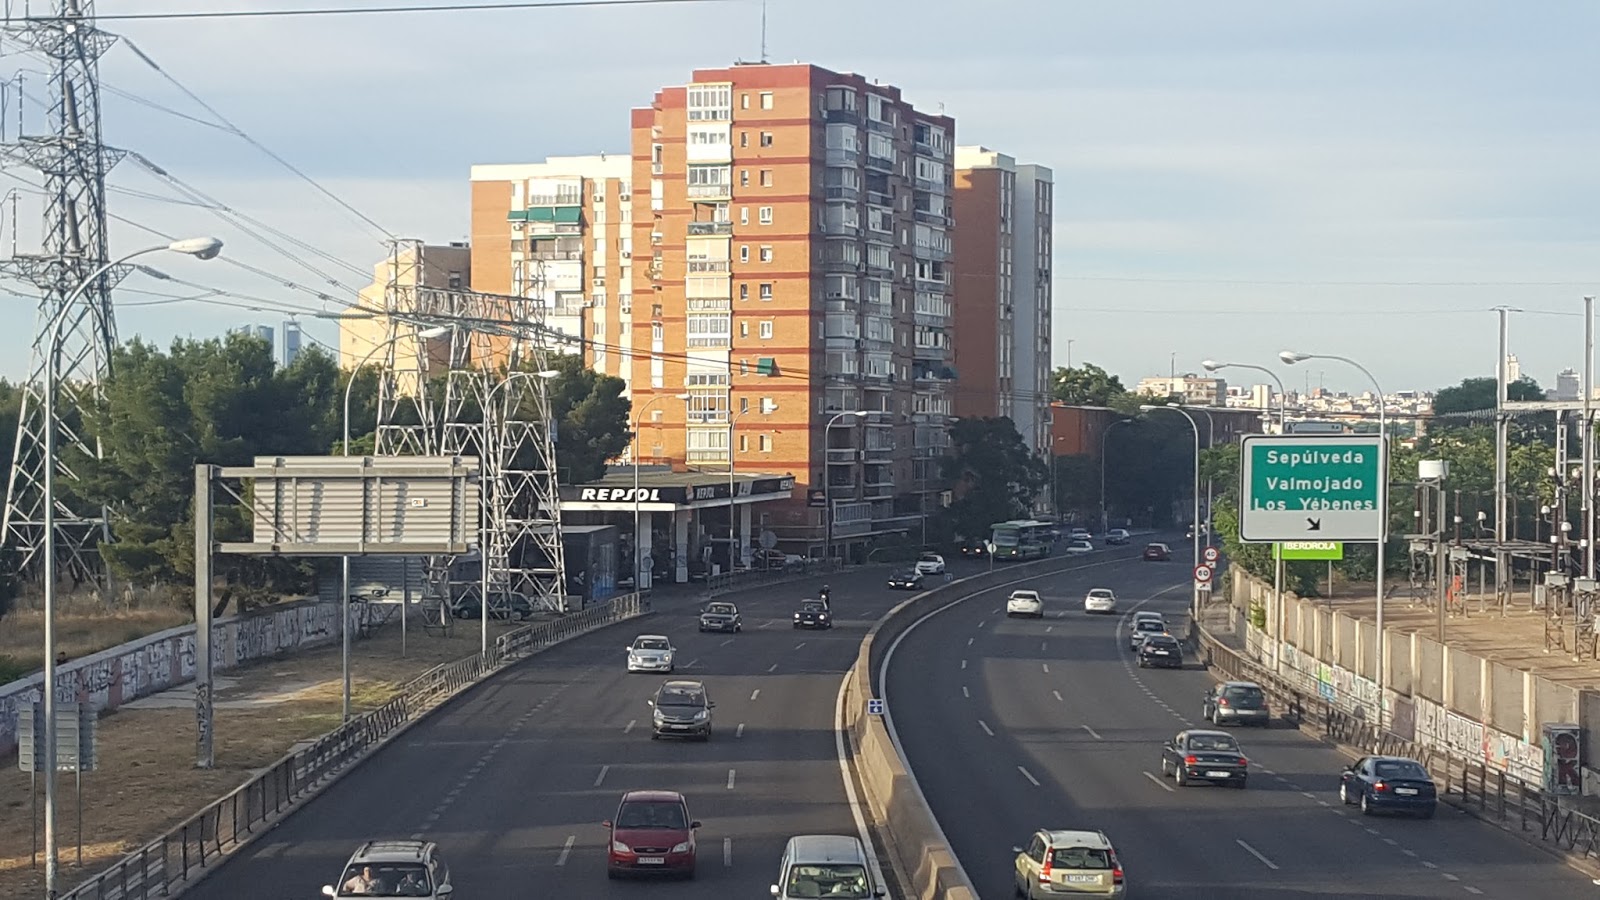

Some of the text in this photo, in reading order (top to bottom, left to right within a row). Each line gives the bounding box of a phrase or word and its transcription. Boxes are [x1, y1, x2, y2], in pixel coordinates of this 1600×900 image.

[1266, 449, 1364, 467] Sepúlveda
[1266, 476, 1363, 493] Valmojado
[581, 488, 660, 501] REPSOL
[1254, 497, 1373, 511] Los Yébenes
[1283, 542, 1337, 551] IBERDROLA
